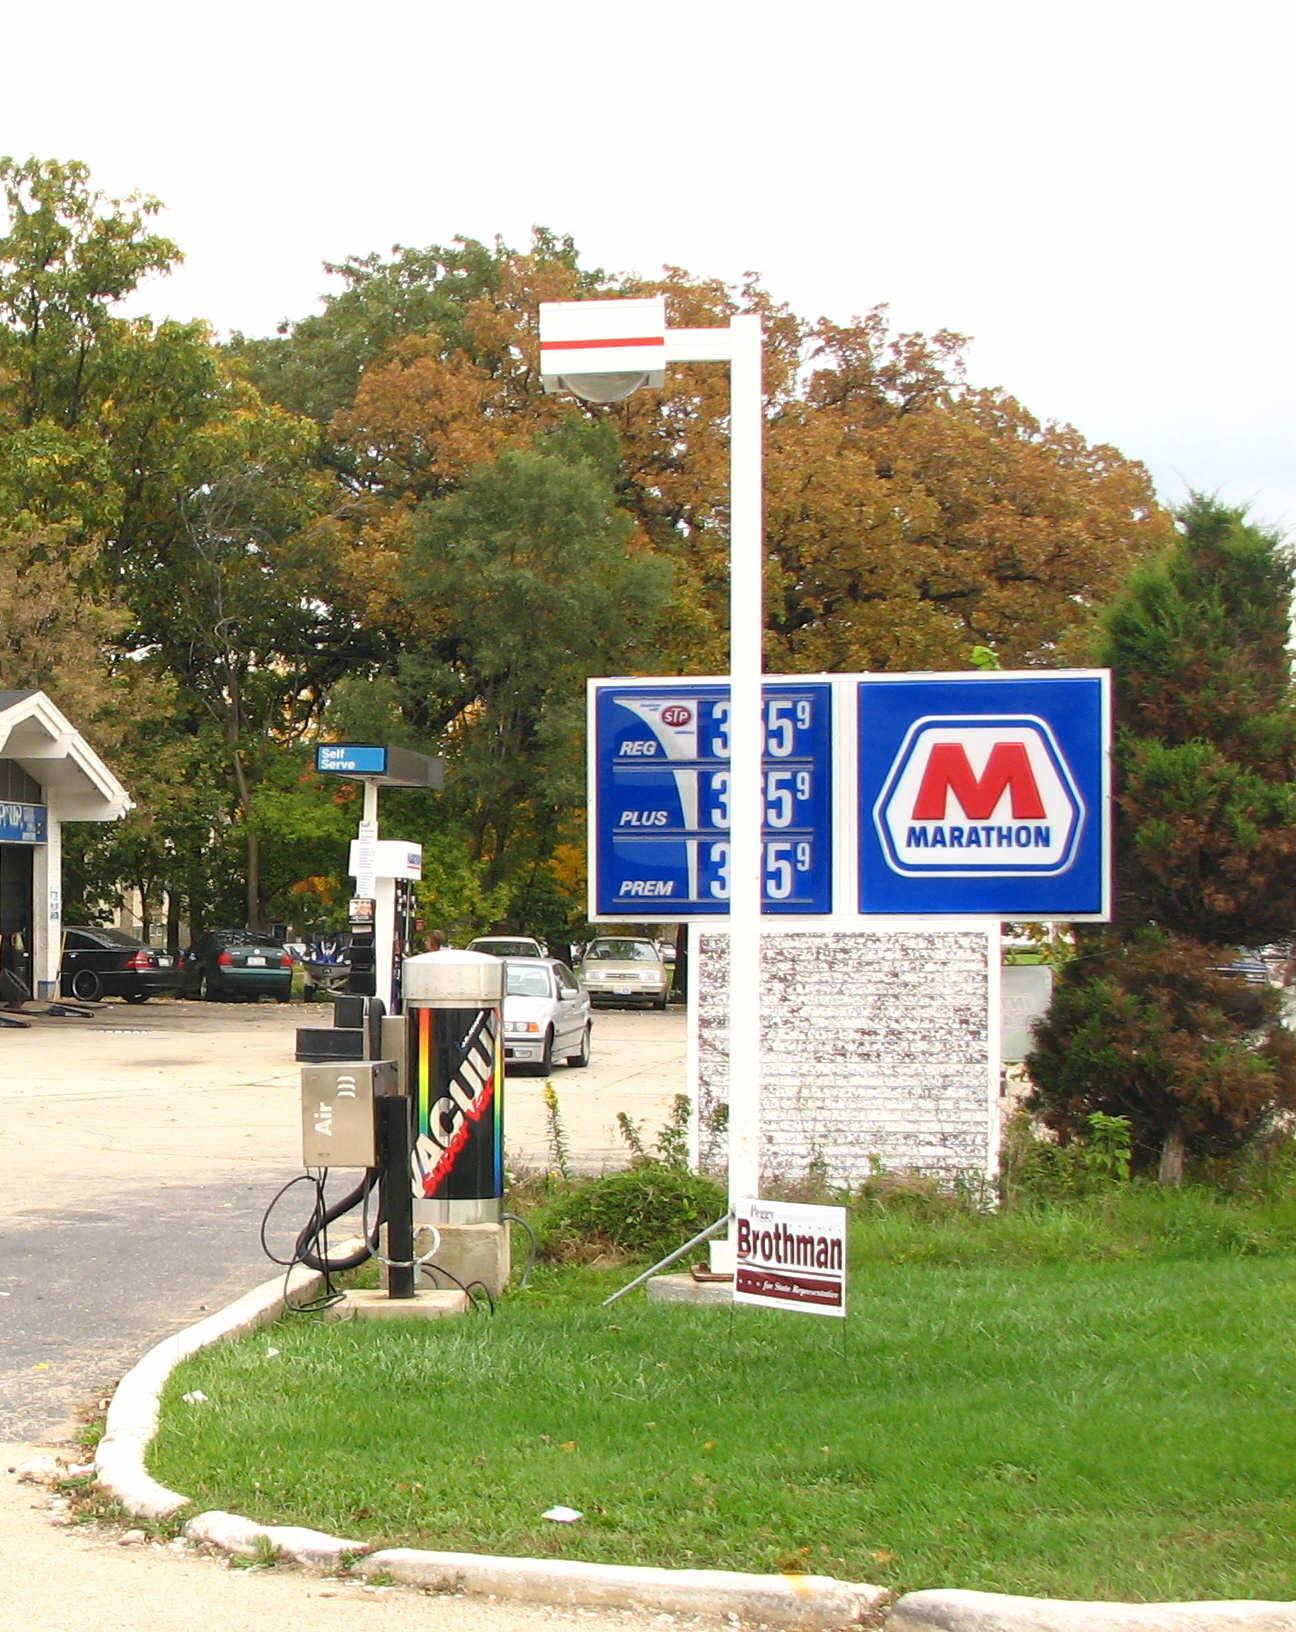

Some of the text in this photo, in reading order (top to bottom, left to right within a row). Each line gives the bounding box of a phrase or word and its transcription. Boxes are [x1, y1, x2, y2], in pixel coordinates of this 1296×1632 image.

[664, 707, 689, 723] STP
[321, 749, 345, 759] Self
[618, 741, 657, 756] REG
[321, 760, 355, 770] Serve
[911, 742, 1047, 820] M
[619, 811, 668, 826] PLUS
[906, 826, 1050, 848] MARATHON
[619, 880, 674, 896] PREM
[314, 1102, 332, 1136] Air
[737, 1218, 842, 1270] Brothman
